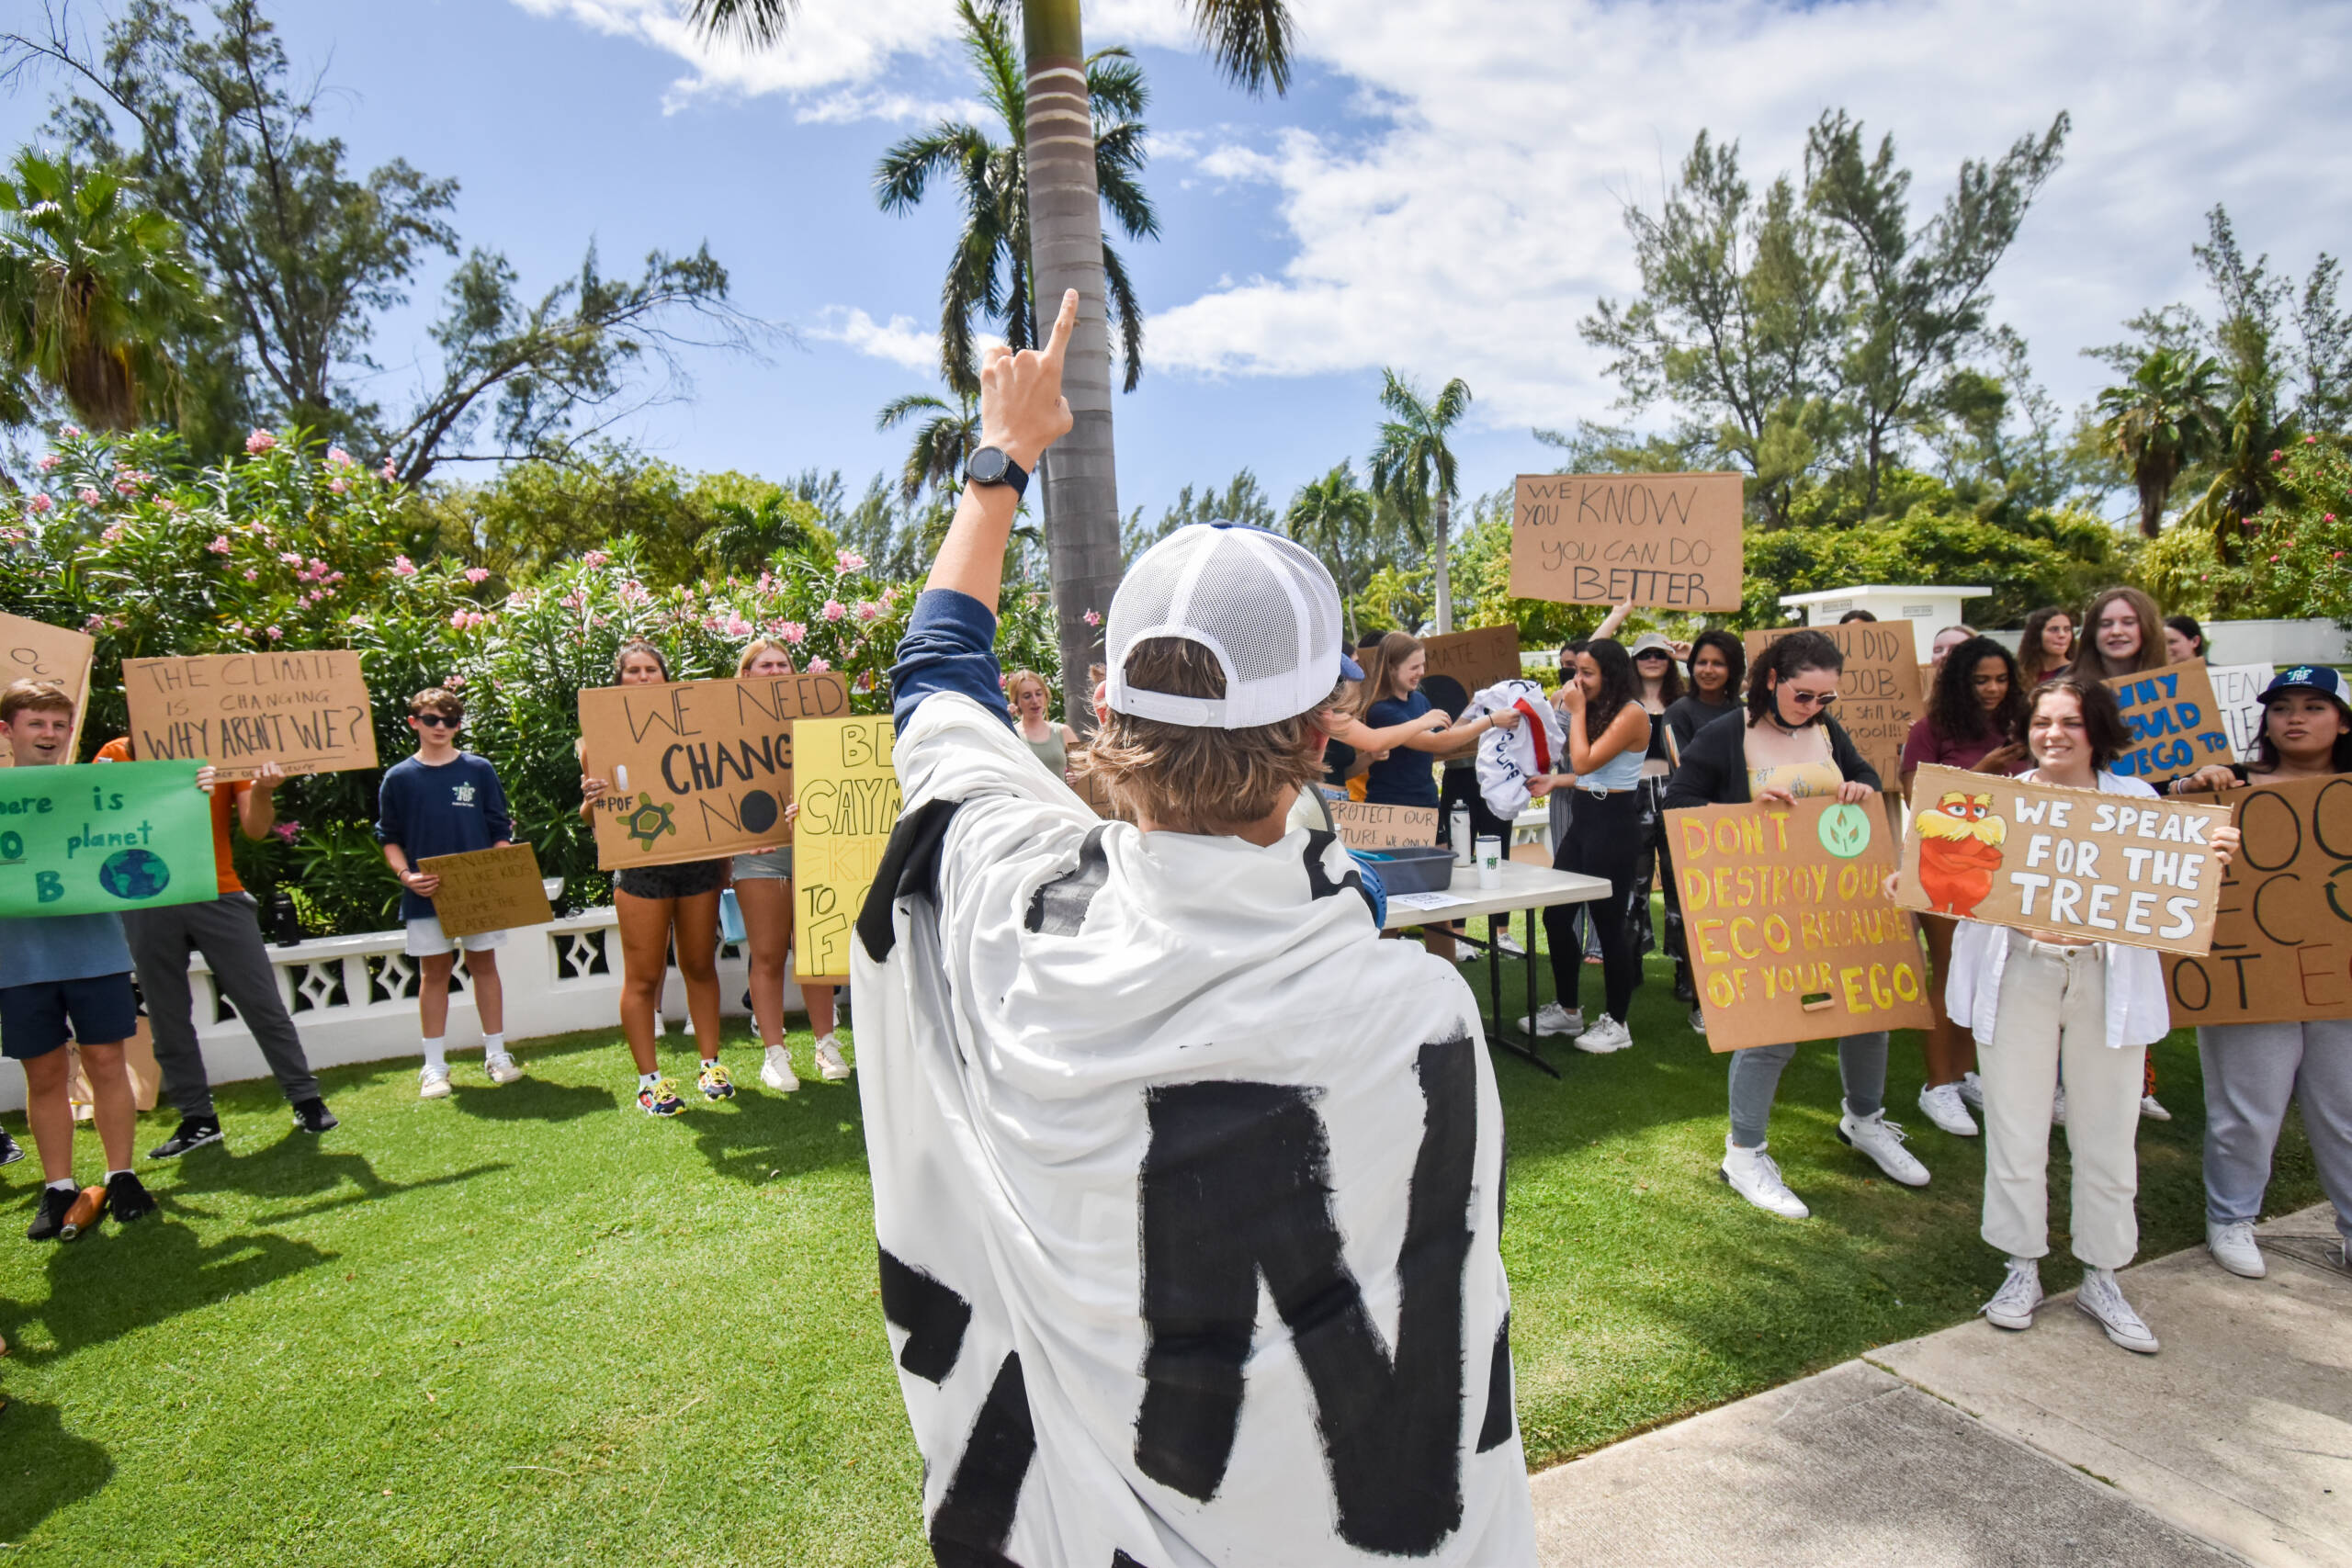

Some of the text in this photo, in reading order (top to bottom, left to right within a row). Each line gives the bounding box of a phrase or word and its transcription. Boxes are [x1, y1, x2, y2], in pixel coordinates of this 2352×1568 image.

[1521, 504, 1559, 526] YOU
[1527, 481, 1698, 525] WE KNOW
[1603, 540, 1659, 565] CAN
[1669, 537, 1712, 567] DO
[1573, 566, 1710, 605] BETTER
[1424, 642, 1477, 671] MATE
[1863, 630, 1899, 662] DID
[136, 655, 343, 694] THE CLIMATE
[1841, 669, 1905, 700] JOB,
[2117, 673, 2178, 709] WHY
[166, 690, 331, 716] IS CHANGING
[624, 677, 843, 743] WE NEED
[1891, 705, 1912, 720] be
[142, 718, 210, 761] WHY
[220, 712, 286, 760] AREN'T
[2196, 731, 2227, 753] TO
[662, 734, 793, 795] CHANG
[0, 786, 124, 815] ere is
[596, 796, 633, 812] #POF
[699, 790, 787, 841] NO
[798, 778, 903, 835] CAYM
[1328, 800, 1436, 827] PROTECT OUR
[0, 820, 153, 859] O planet
[1679, 810, 1791, 860] DON'T
[2014, 796, 2211, 845] WE SPEAK
[466, 869, 493, 884] LIKE
[500, 863, 534, 878] KIDS
[2026, 834, 2205, 890] FOR THE
[35, 871, 65, 903] B
[802, 884, 837, 917] TO
[1681, 864, 1827, 912] DESTROY
[2010, 872, 2199, 940] TREES
[1693, 906, 1911, 964] ECO BECAUSE
[1706, 968, 1748, 1009] OF
[1759, 962, 1835, 999] YOUR
[2173, 953, 2262, 1011] OT
